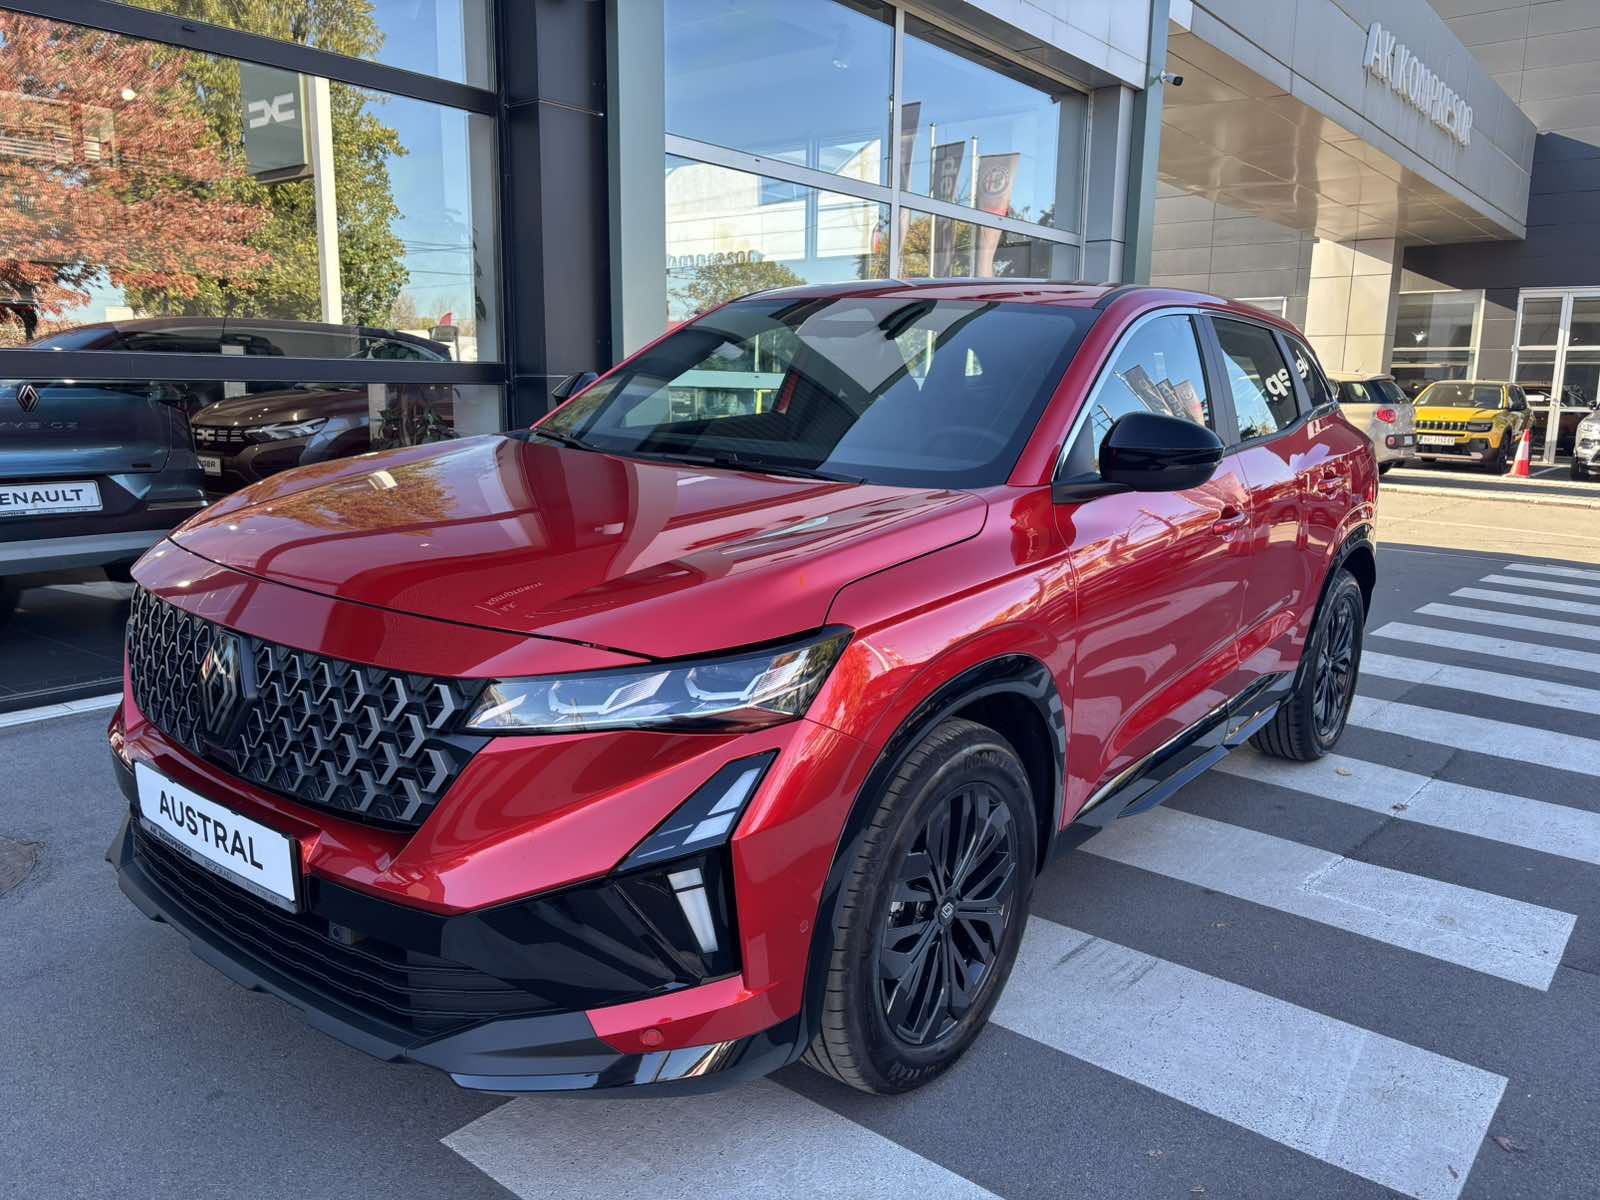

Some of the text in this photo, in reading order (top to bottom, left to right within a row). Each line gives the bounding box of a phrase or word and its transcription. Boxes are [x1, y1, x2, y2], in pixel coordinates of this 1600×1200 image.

[1364, 22, 1473, 146] AK KOMPRESOR
[0, 488, 83, 505] ENAULT
[160, 790, 264, 871] AUSTRAL
